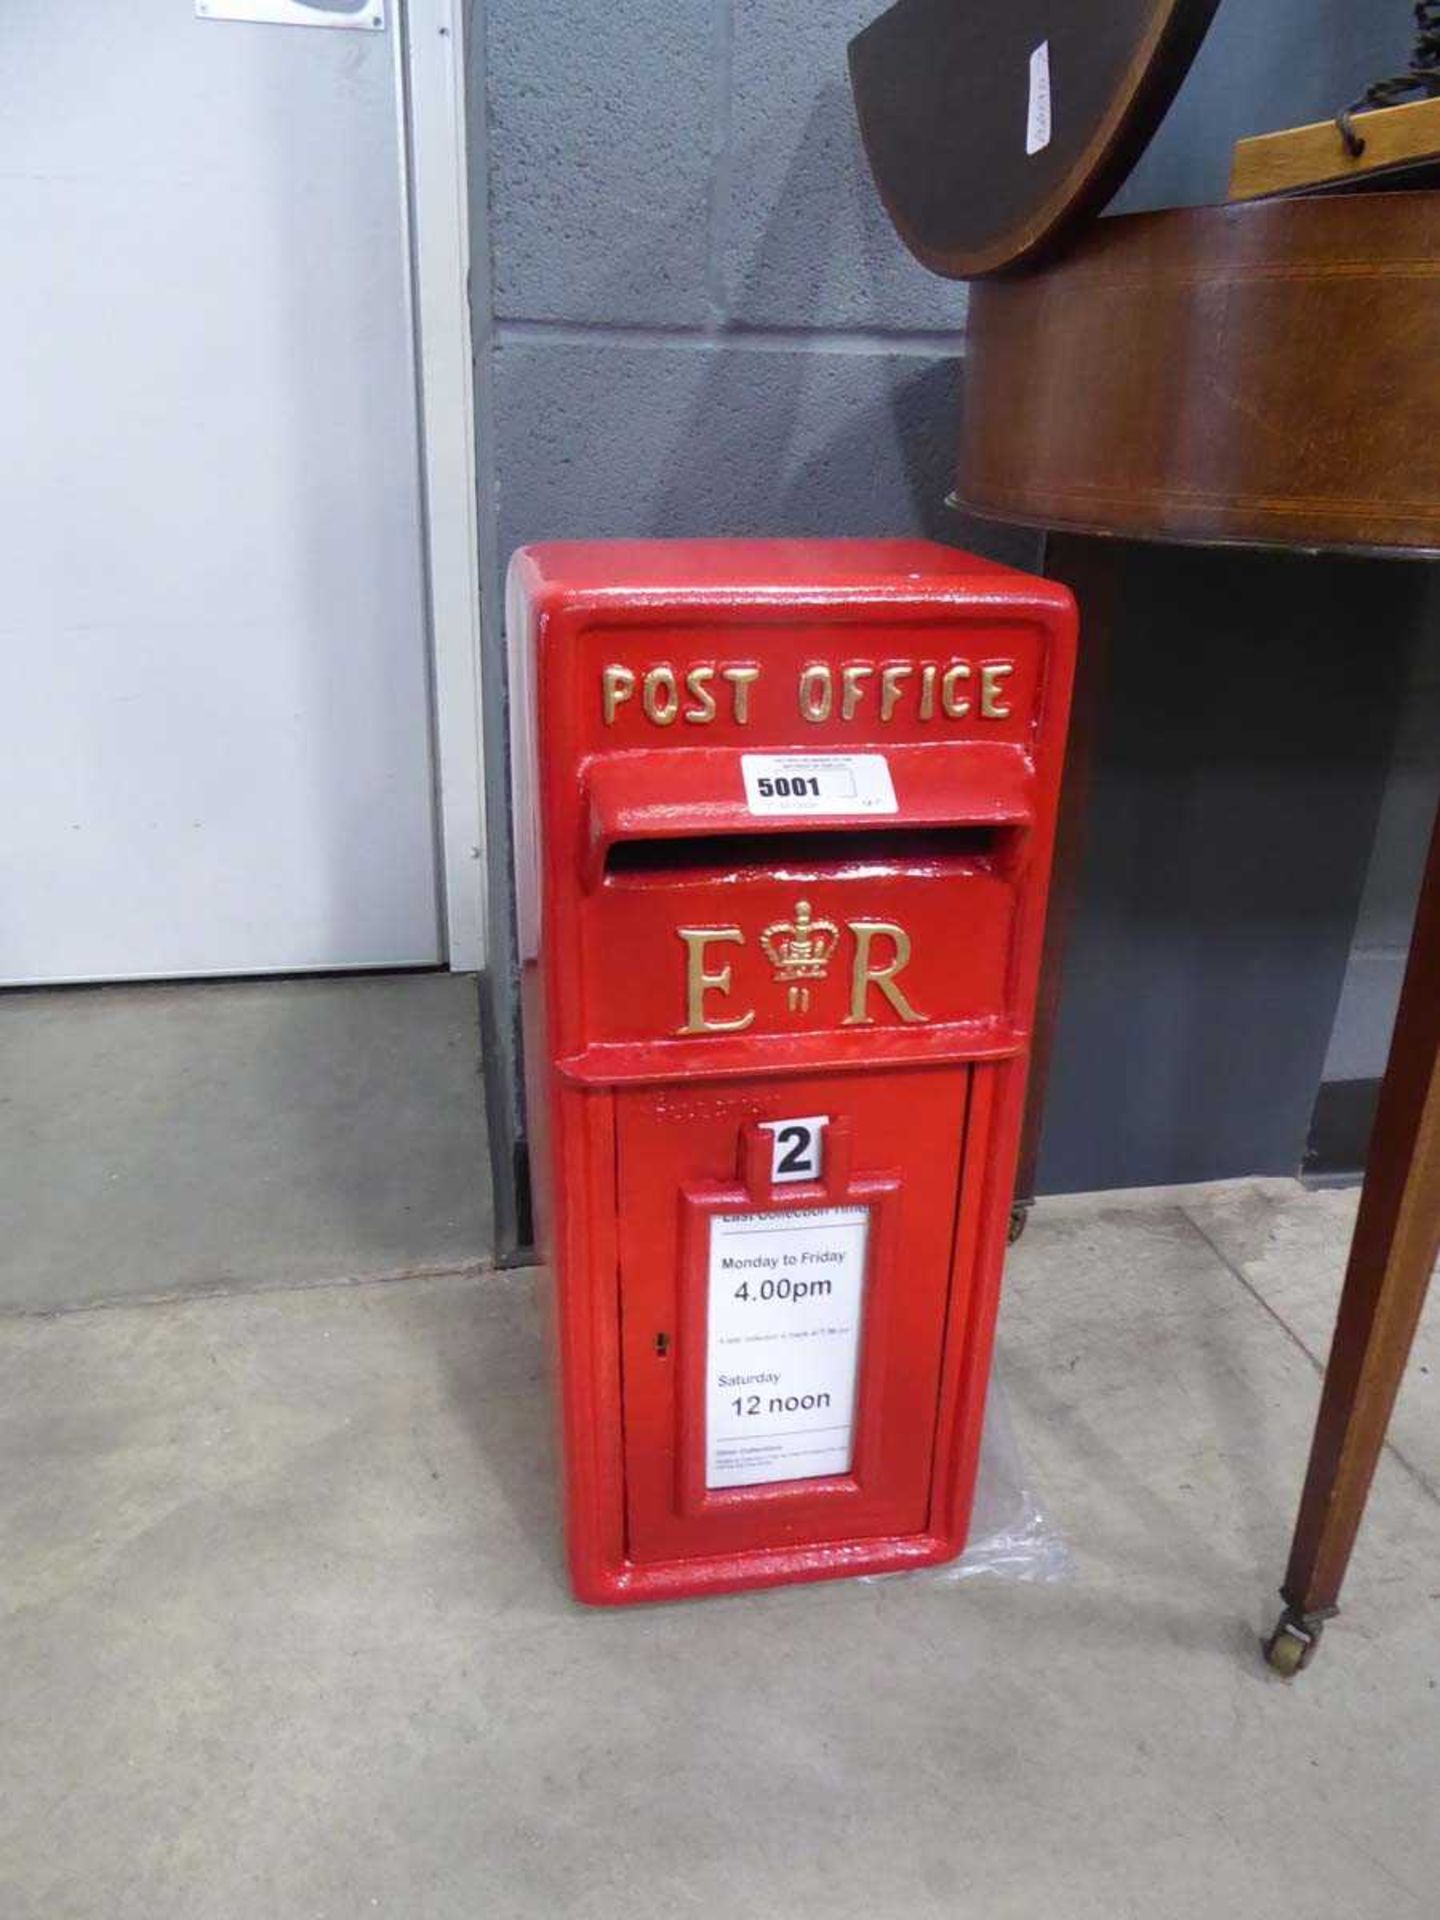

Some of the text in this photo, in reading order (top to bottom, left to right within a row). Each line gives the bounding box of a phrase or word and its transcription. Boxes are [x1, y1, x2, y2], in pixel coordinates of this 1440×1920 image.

[603, 663, 1014, 726] POST OFFICE
[757, 776, 821, 798] 5001
[671, 918, 931, 1035] E R
[776, 1125, 812, 1174] 2
[721, 1250, 846, 1271] Monday to Friday
[734, 1277, 833, 1303] 4.00pm
[717, 1371, 782, 1388] Saturday
[731, 1392, 831, 1417] 12 noon
